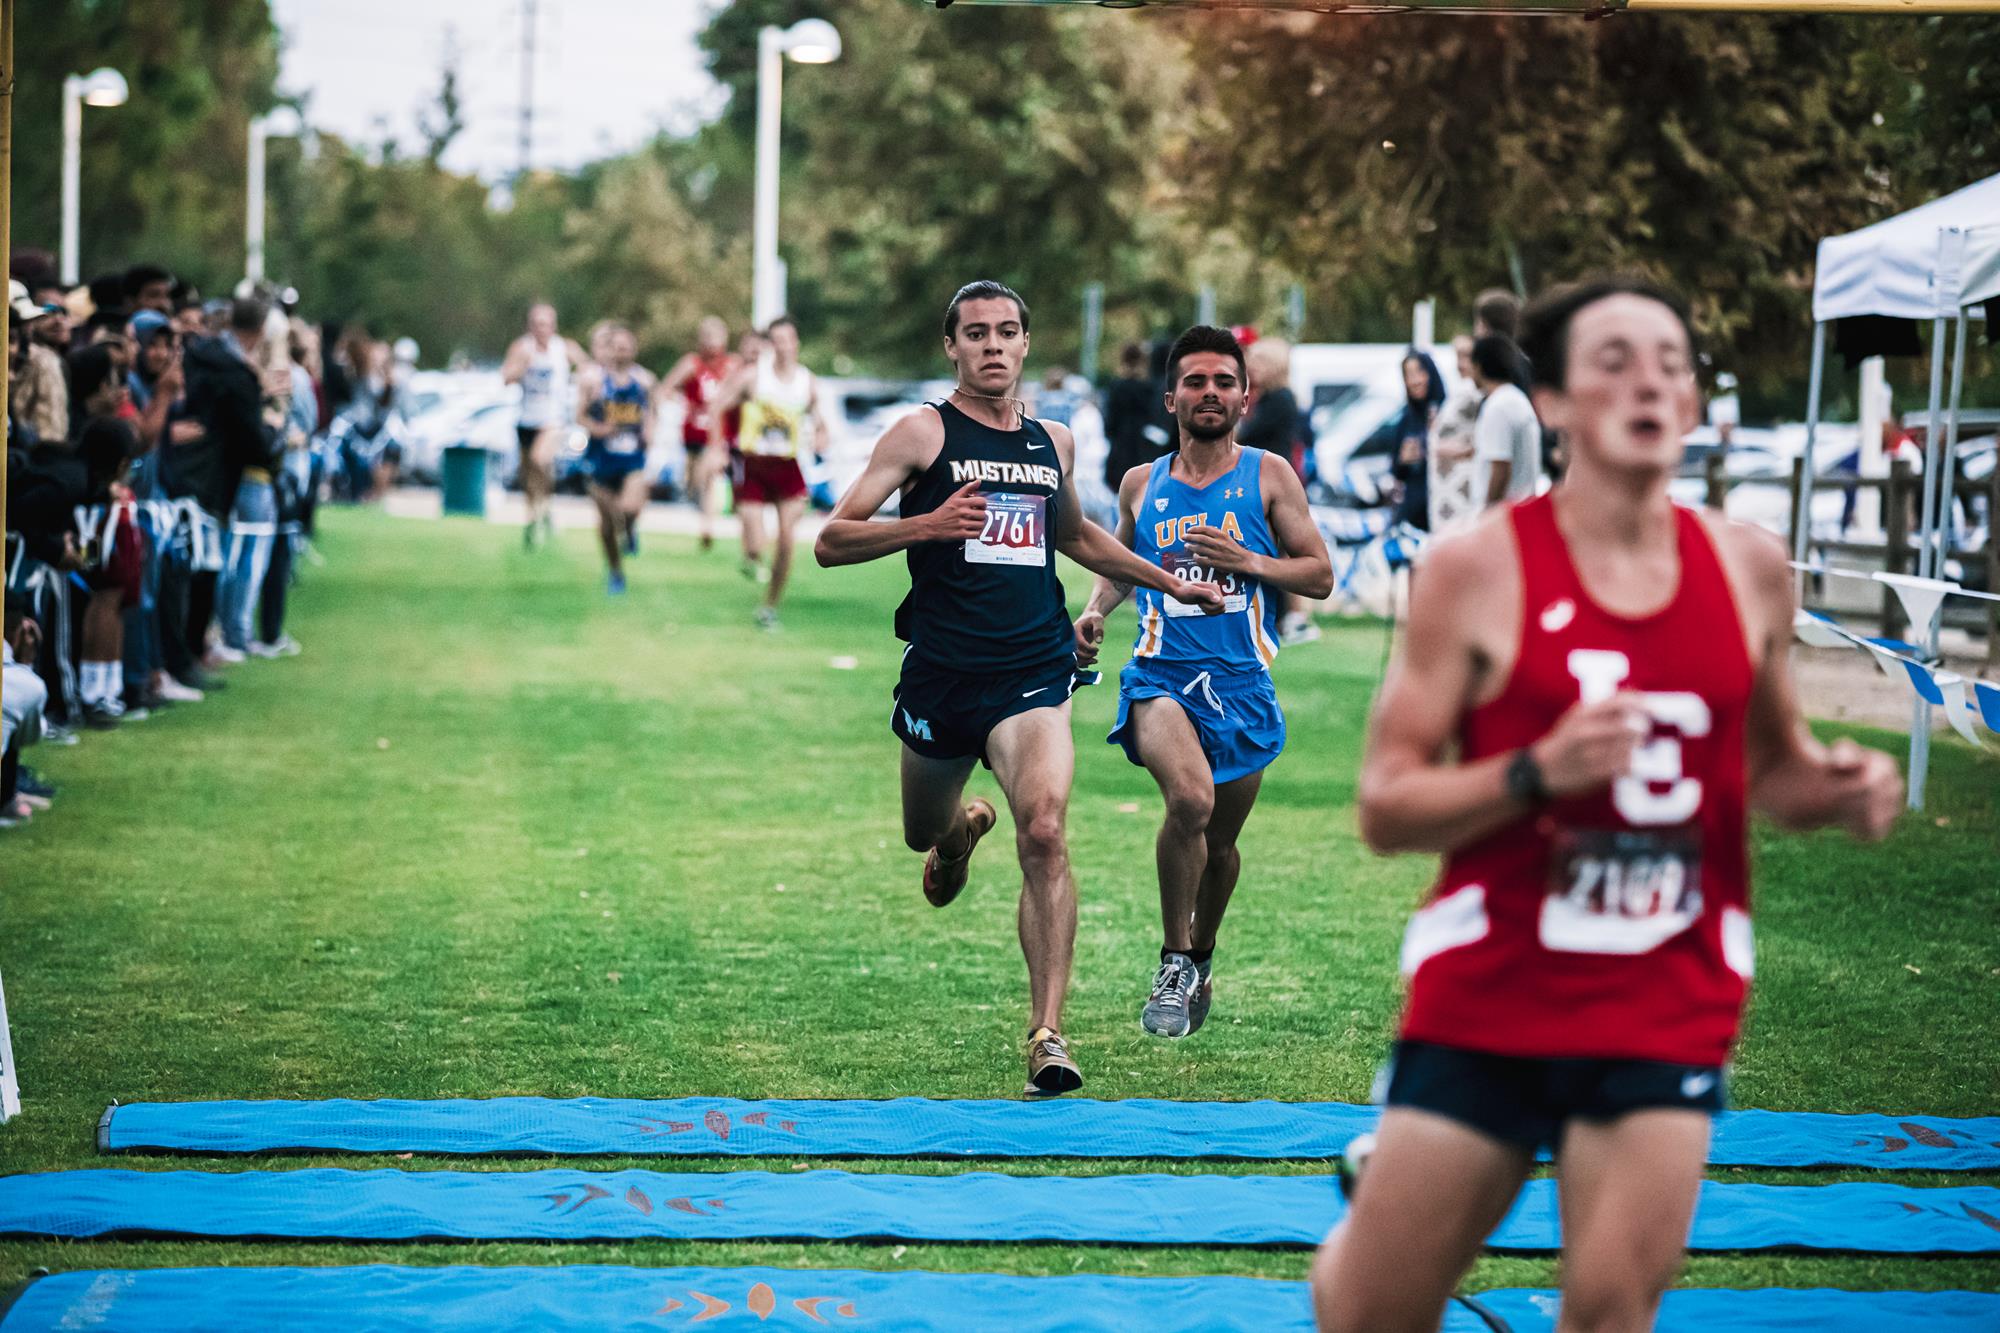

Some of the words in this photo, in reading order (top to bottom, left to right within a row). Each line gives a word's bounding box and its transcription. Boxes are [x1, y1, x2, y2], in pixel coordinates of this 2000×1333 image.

[949, 460, 1059, 491] MUSTANGS
[980, 510, 1035, 544] 2761
[902, 707, 935, 741] M
